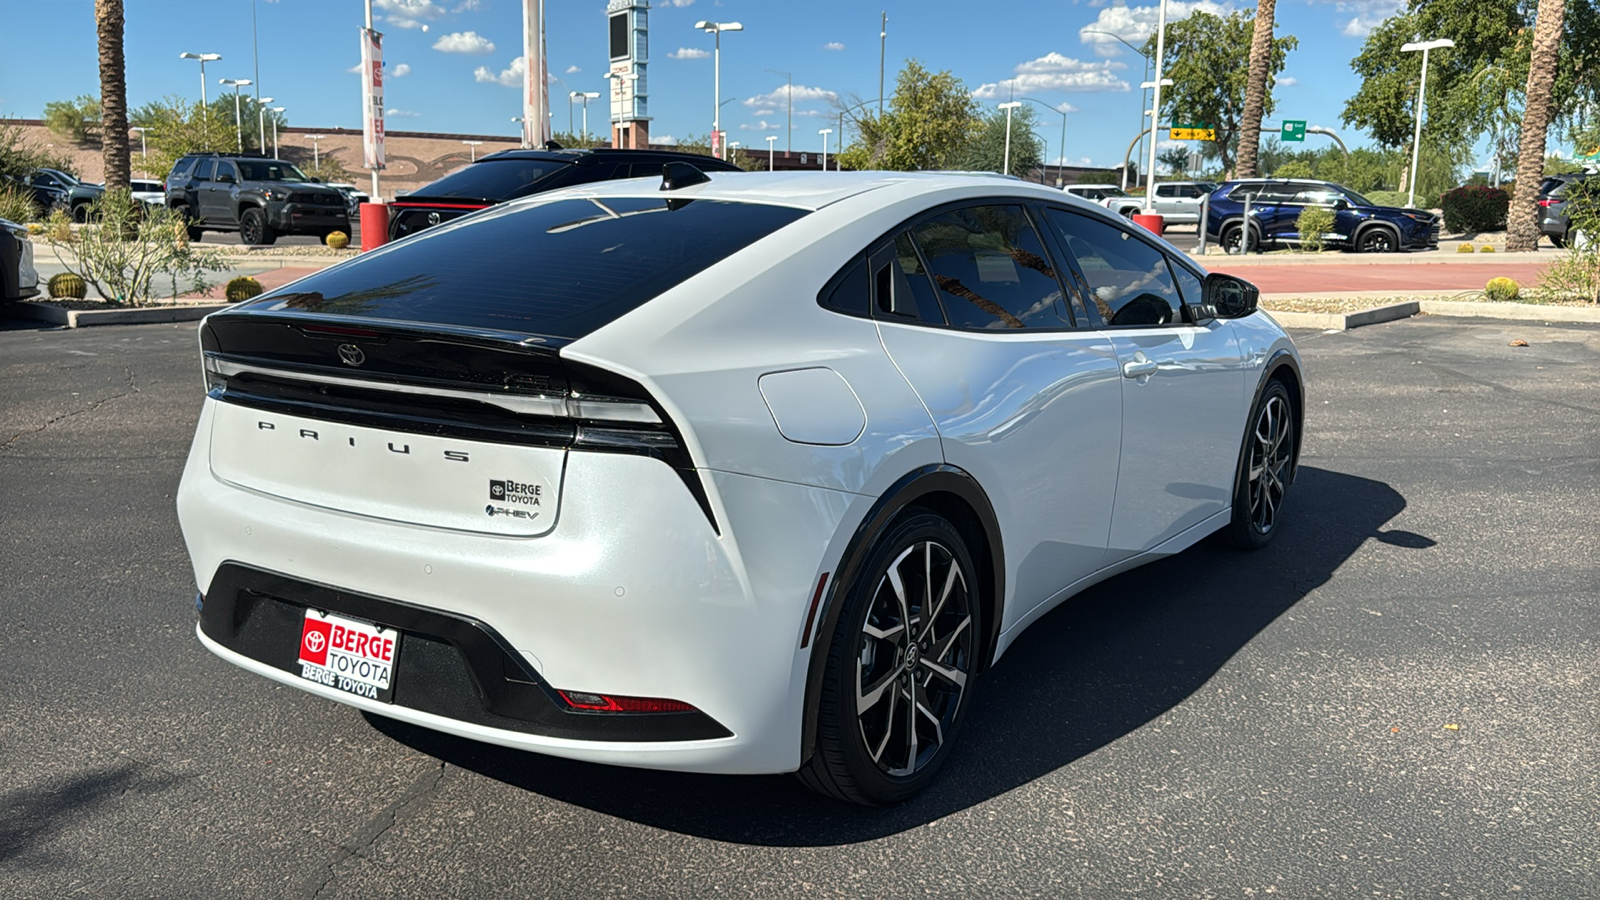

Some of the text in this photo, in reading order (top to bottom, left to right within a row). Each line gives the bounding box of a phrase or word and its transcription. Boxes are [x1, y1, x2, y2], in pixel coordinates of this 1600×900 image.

[258, 421, 470, 462] PRIUS
[506, 480, 542, 496] BERGE
[506, 493, 541, 506] TOYOTA
[331, 624, 393, 662] BERGE
[301, 663, 378, 699] BERGE TOYOTA
[329, 652, 389, 684] TOYOTA
